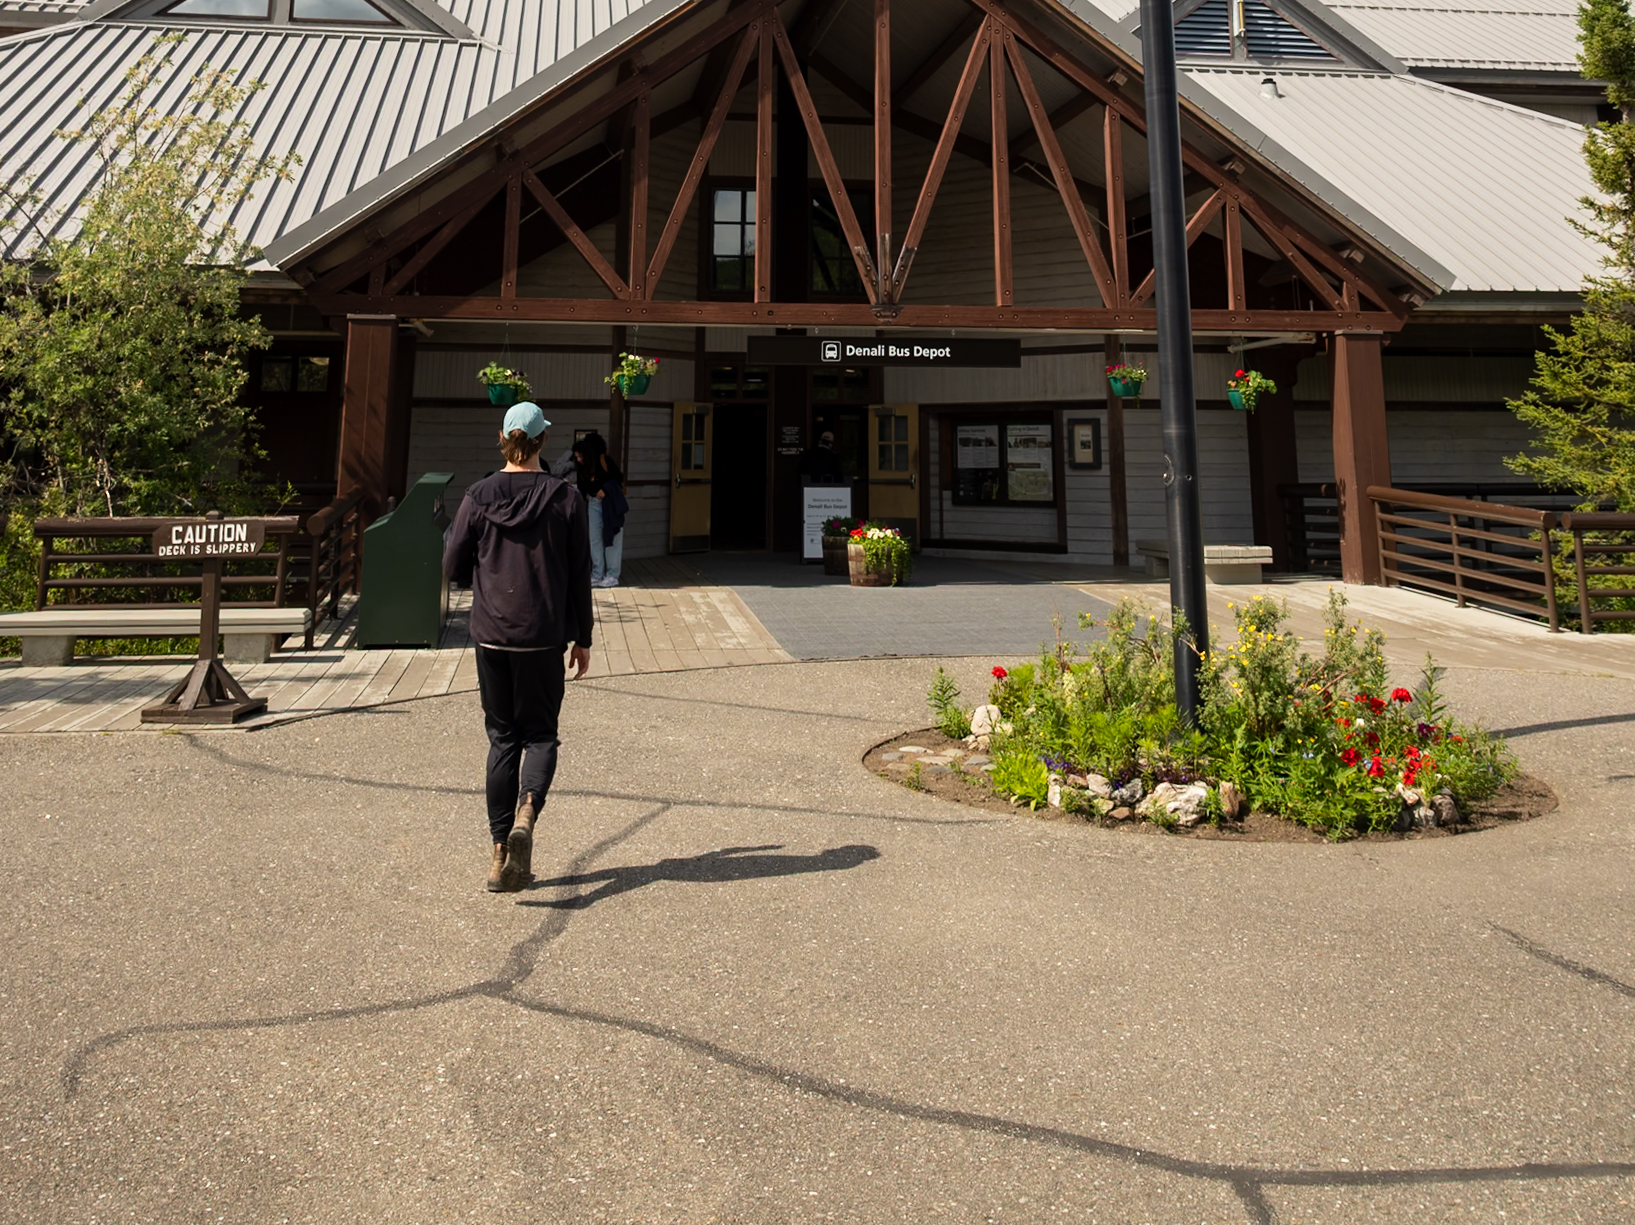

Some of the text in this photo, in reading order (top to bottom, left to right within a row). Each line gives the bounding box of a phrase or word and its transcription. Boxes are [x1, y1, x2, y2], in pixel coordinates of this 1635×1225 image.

[846, 345, 951, 360] Denali Bus Depot
[171, 523, 247, 545] CAUTION
[158, 542, 256, 556] DECK IS SLIPPERY
